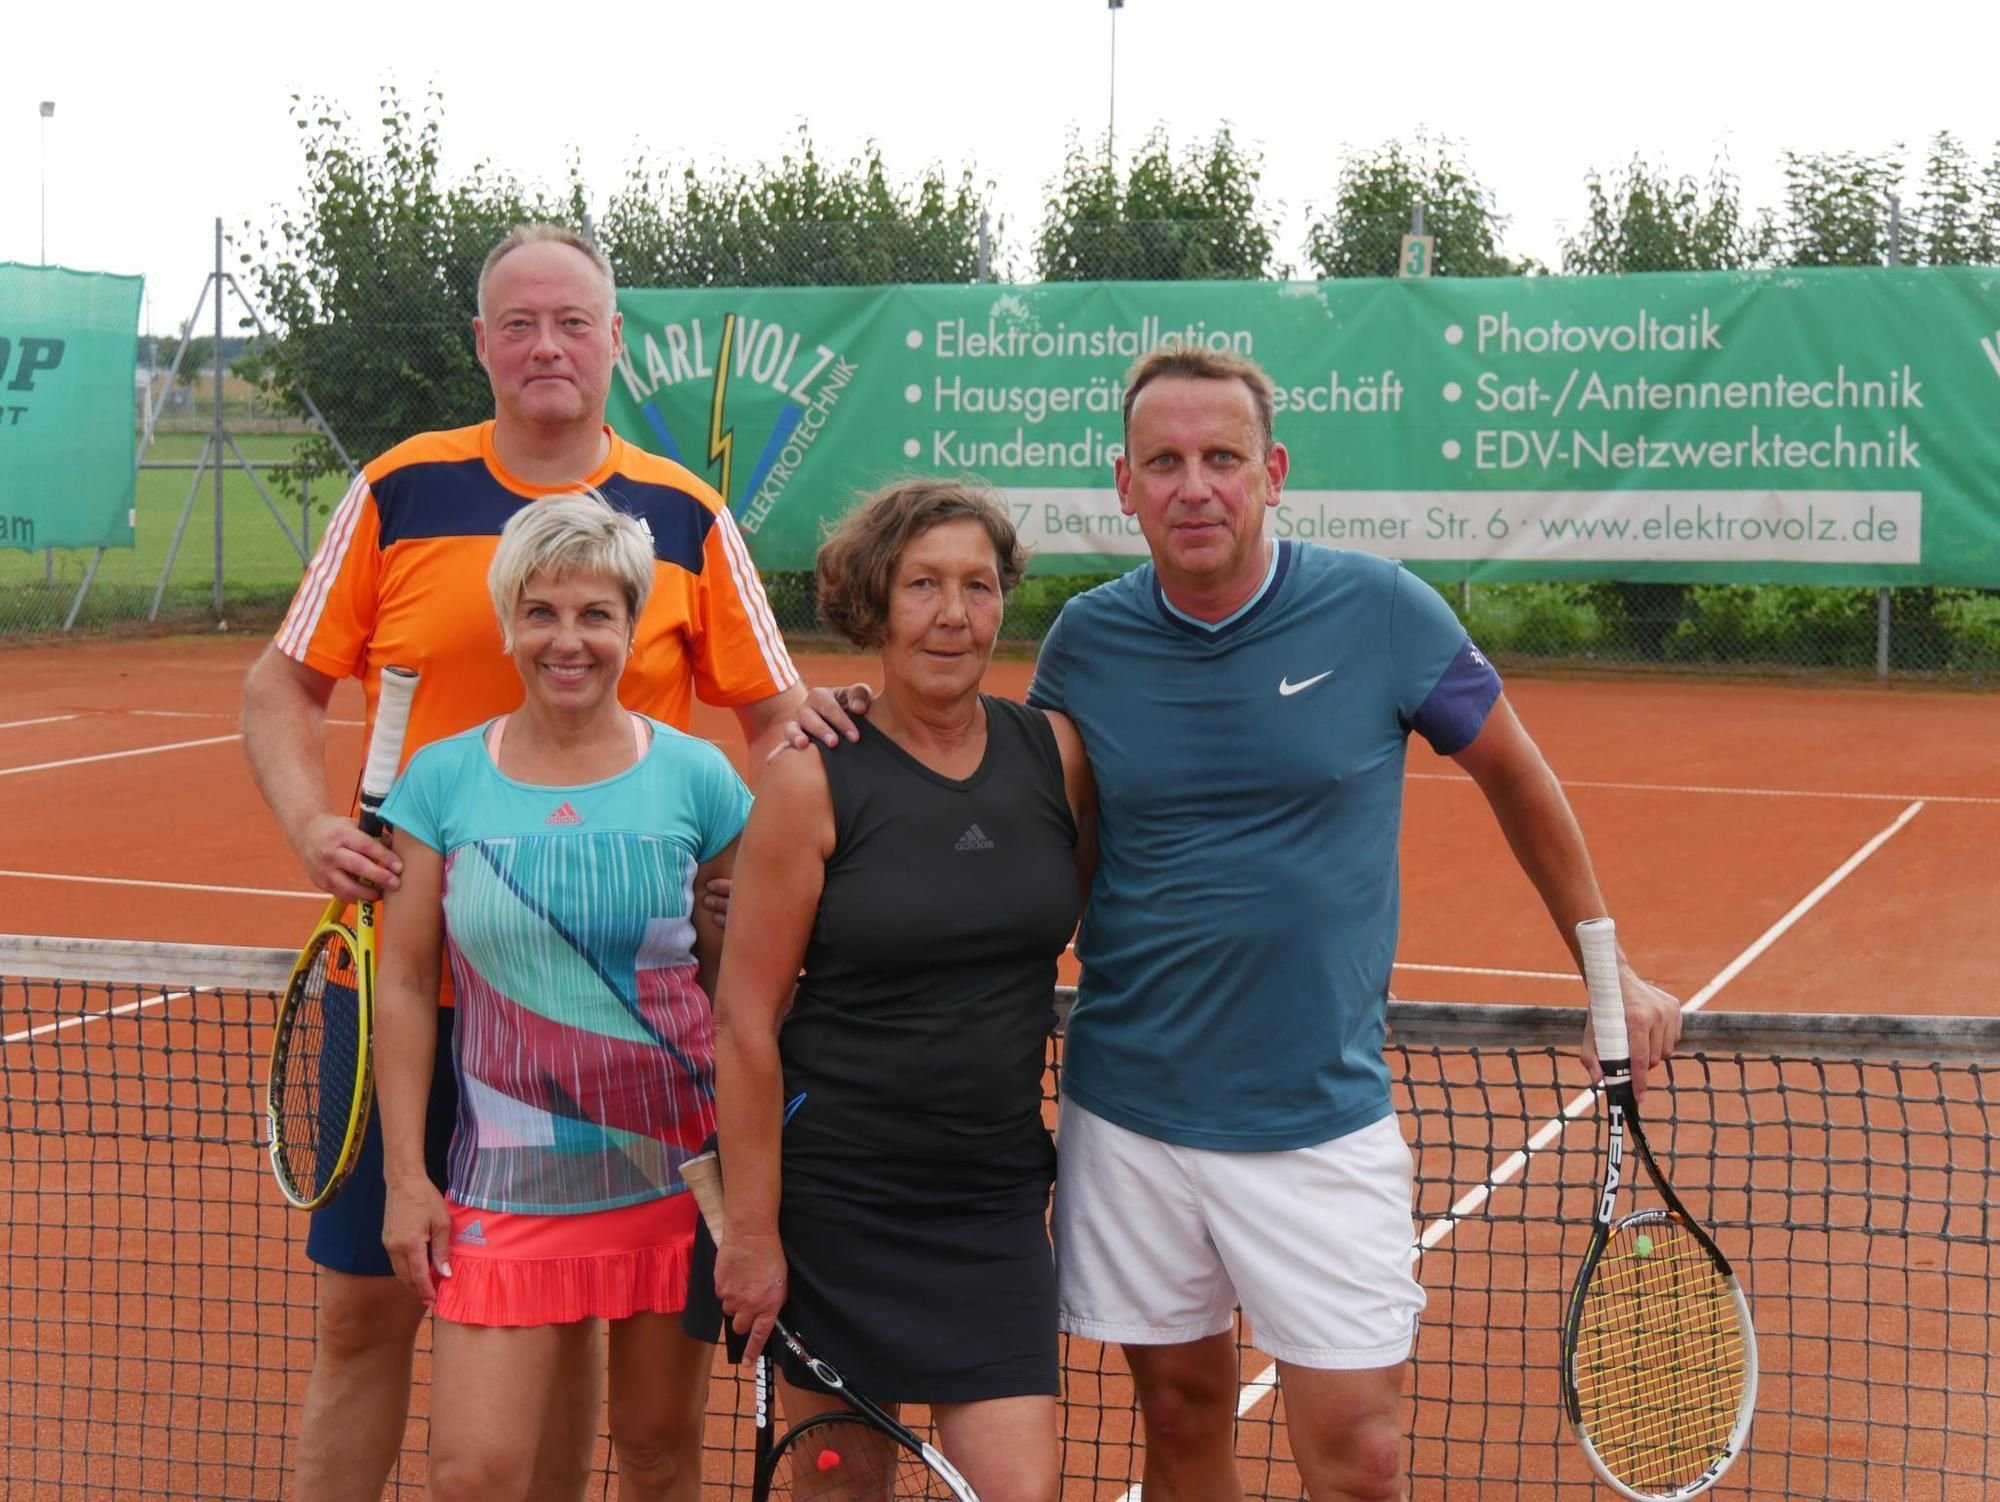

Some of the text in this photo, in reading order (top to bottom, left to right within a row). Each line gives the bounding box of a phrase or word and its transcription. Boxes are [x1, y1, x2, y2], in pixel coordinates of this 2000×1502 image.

[1407, 240, 1425, 276] 3
[935, 315, 1254, 357] Elektroinstallation
[1478, 308, 1723, 353] Photovoltaik
[616, 316, 836, 405] KARL VOLZ
[934, 370, 1404, 423] Hausgerät eschäft
[1475, 364, 1925, 417] Sat-/Antennentechnik
[741, 355, 859, 535] ELEKTROTECHNIK
[933, 427, 1125, 467] Kundendie
[1475, 424, 1921, 469] EDV-Netzwerktechnik
[1274, 504, 1899, 542] Salemer Str. 6 www.elektrovolz.de
[1599, 1104, 1623, 1224] HEAD
